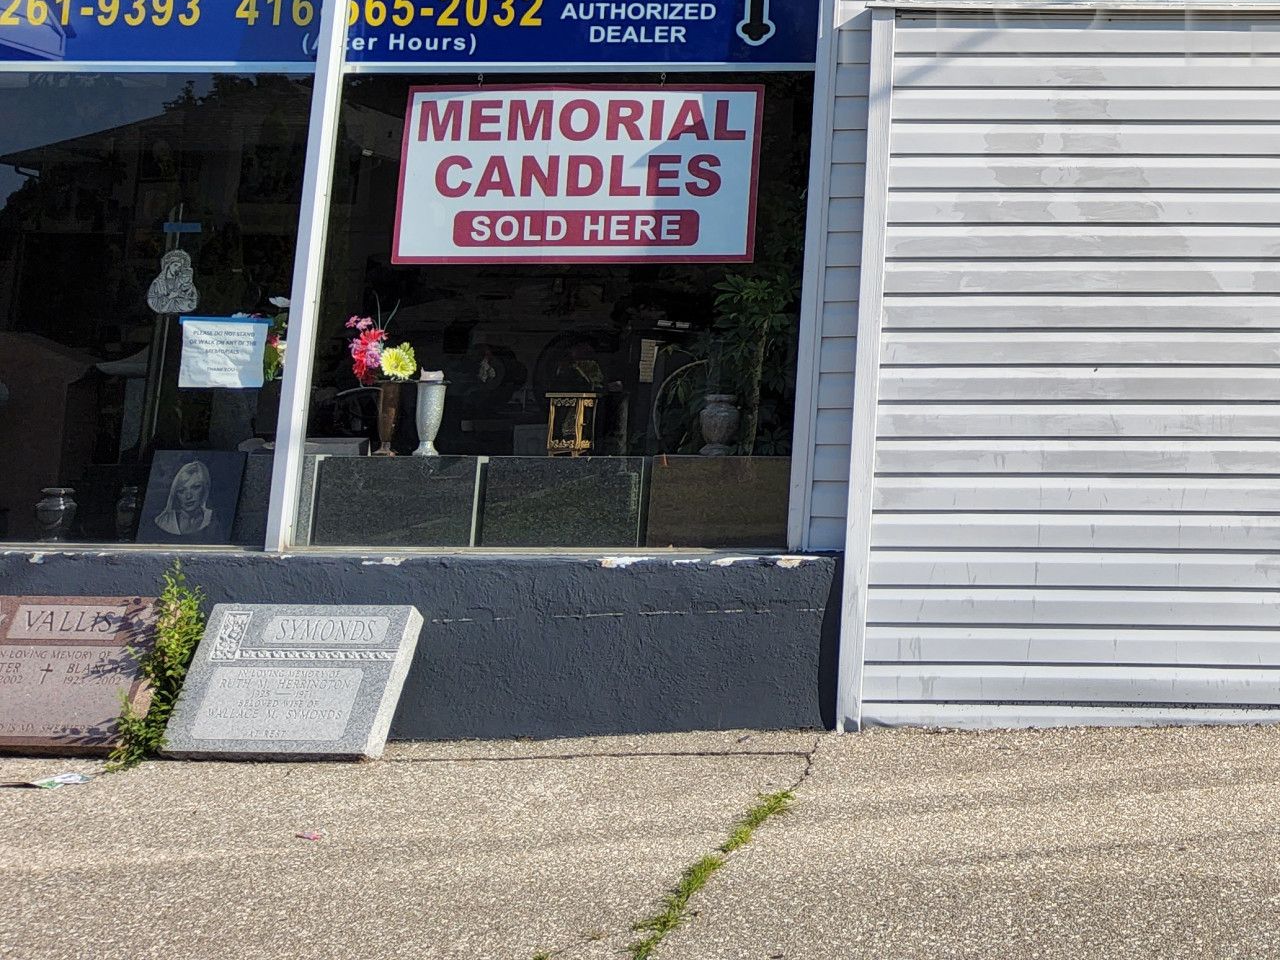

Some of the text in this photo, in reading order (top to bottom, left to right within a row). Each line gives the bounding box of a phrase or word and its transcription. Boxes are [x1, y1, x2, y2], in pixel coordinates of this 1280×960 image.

[560, 1, 717, 21] AUTHORIZED
[388, 32, 478, 54] Hours)
[588, 25, 687, 44] DEALER
[417, 99, 747, 144] MEMORIAL
[434, 153, 723, 199] CANDLES
[469, 212, 683, 243] SOLD HERE
[26, 610, 116, 632] VALLIS
[276, 619, 377, 641] SYMONDS
[219, 678, 252, 689] RUTH
[276, 679, 351, 689] HERRINGTON
[207, 708, 259, 719] WALLACE
[285, 709, 343, 720] SYMONDS
[263, 730, 287, 738] REST
